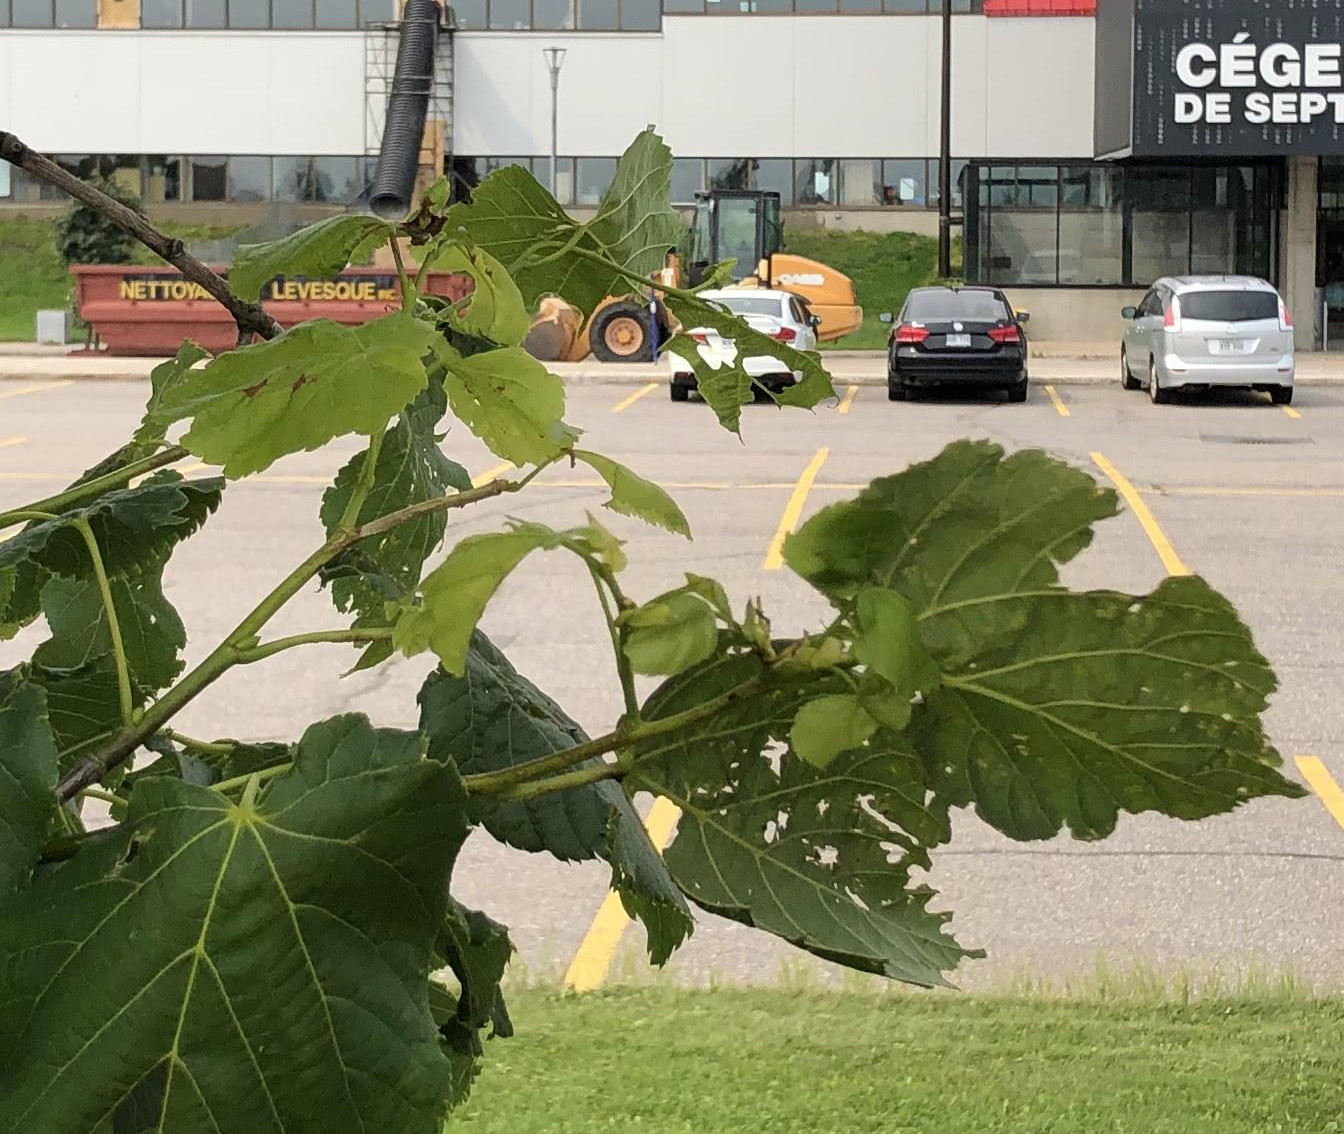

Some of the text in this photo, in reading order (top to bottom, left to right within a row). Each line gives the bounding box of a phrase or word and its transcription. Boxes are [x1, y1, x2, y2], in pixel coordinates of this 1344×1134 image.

[1173, 92, 1232, 124] DE
[120, 280, 217, 300] NETTOYA
[271, 281, 377, 300] LEVESQUE
